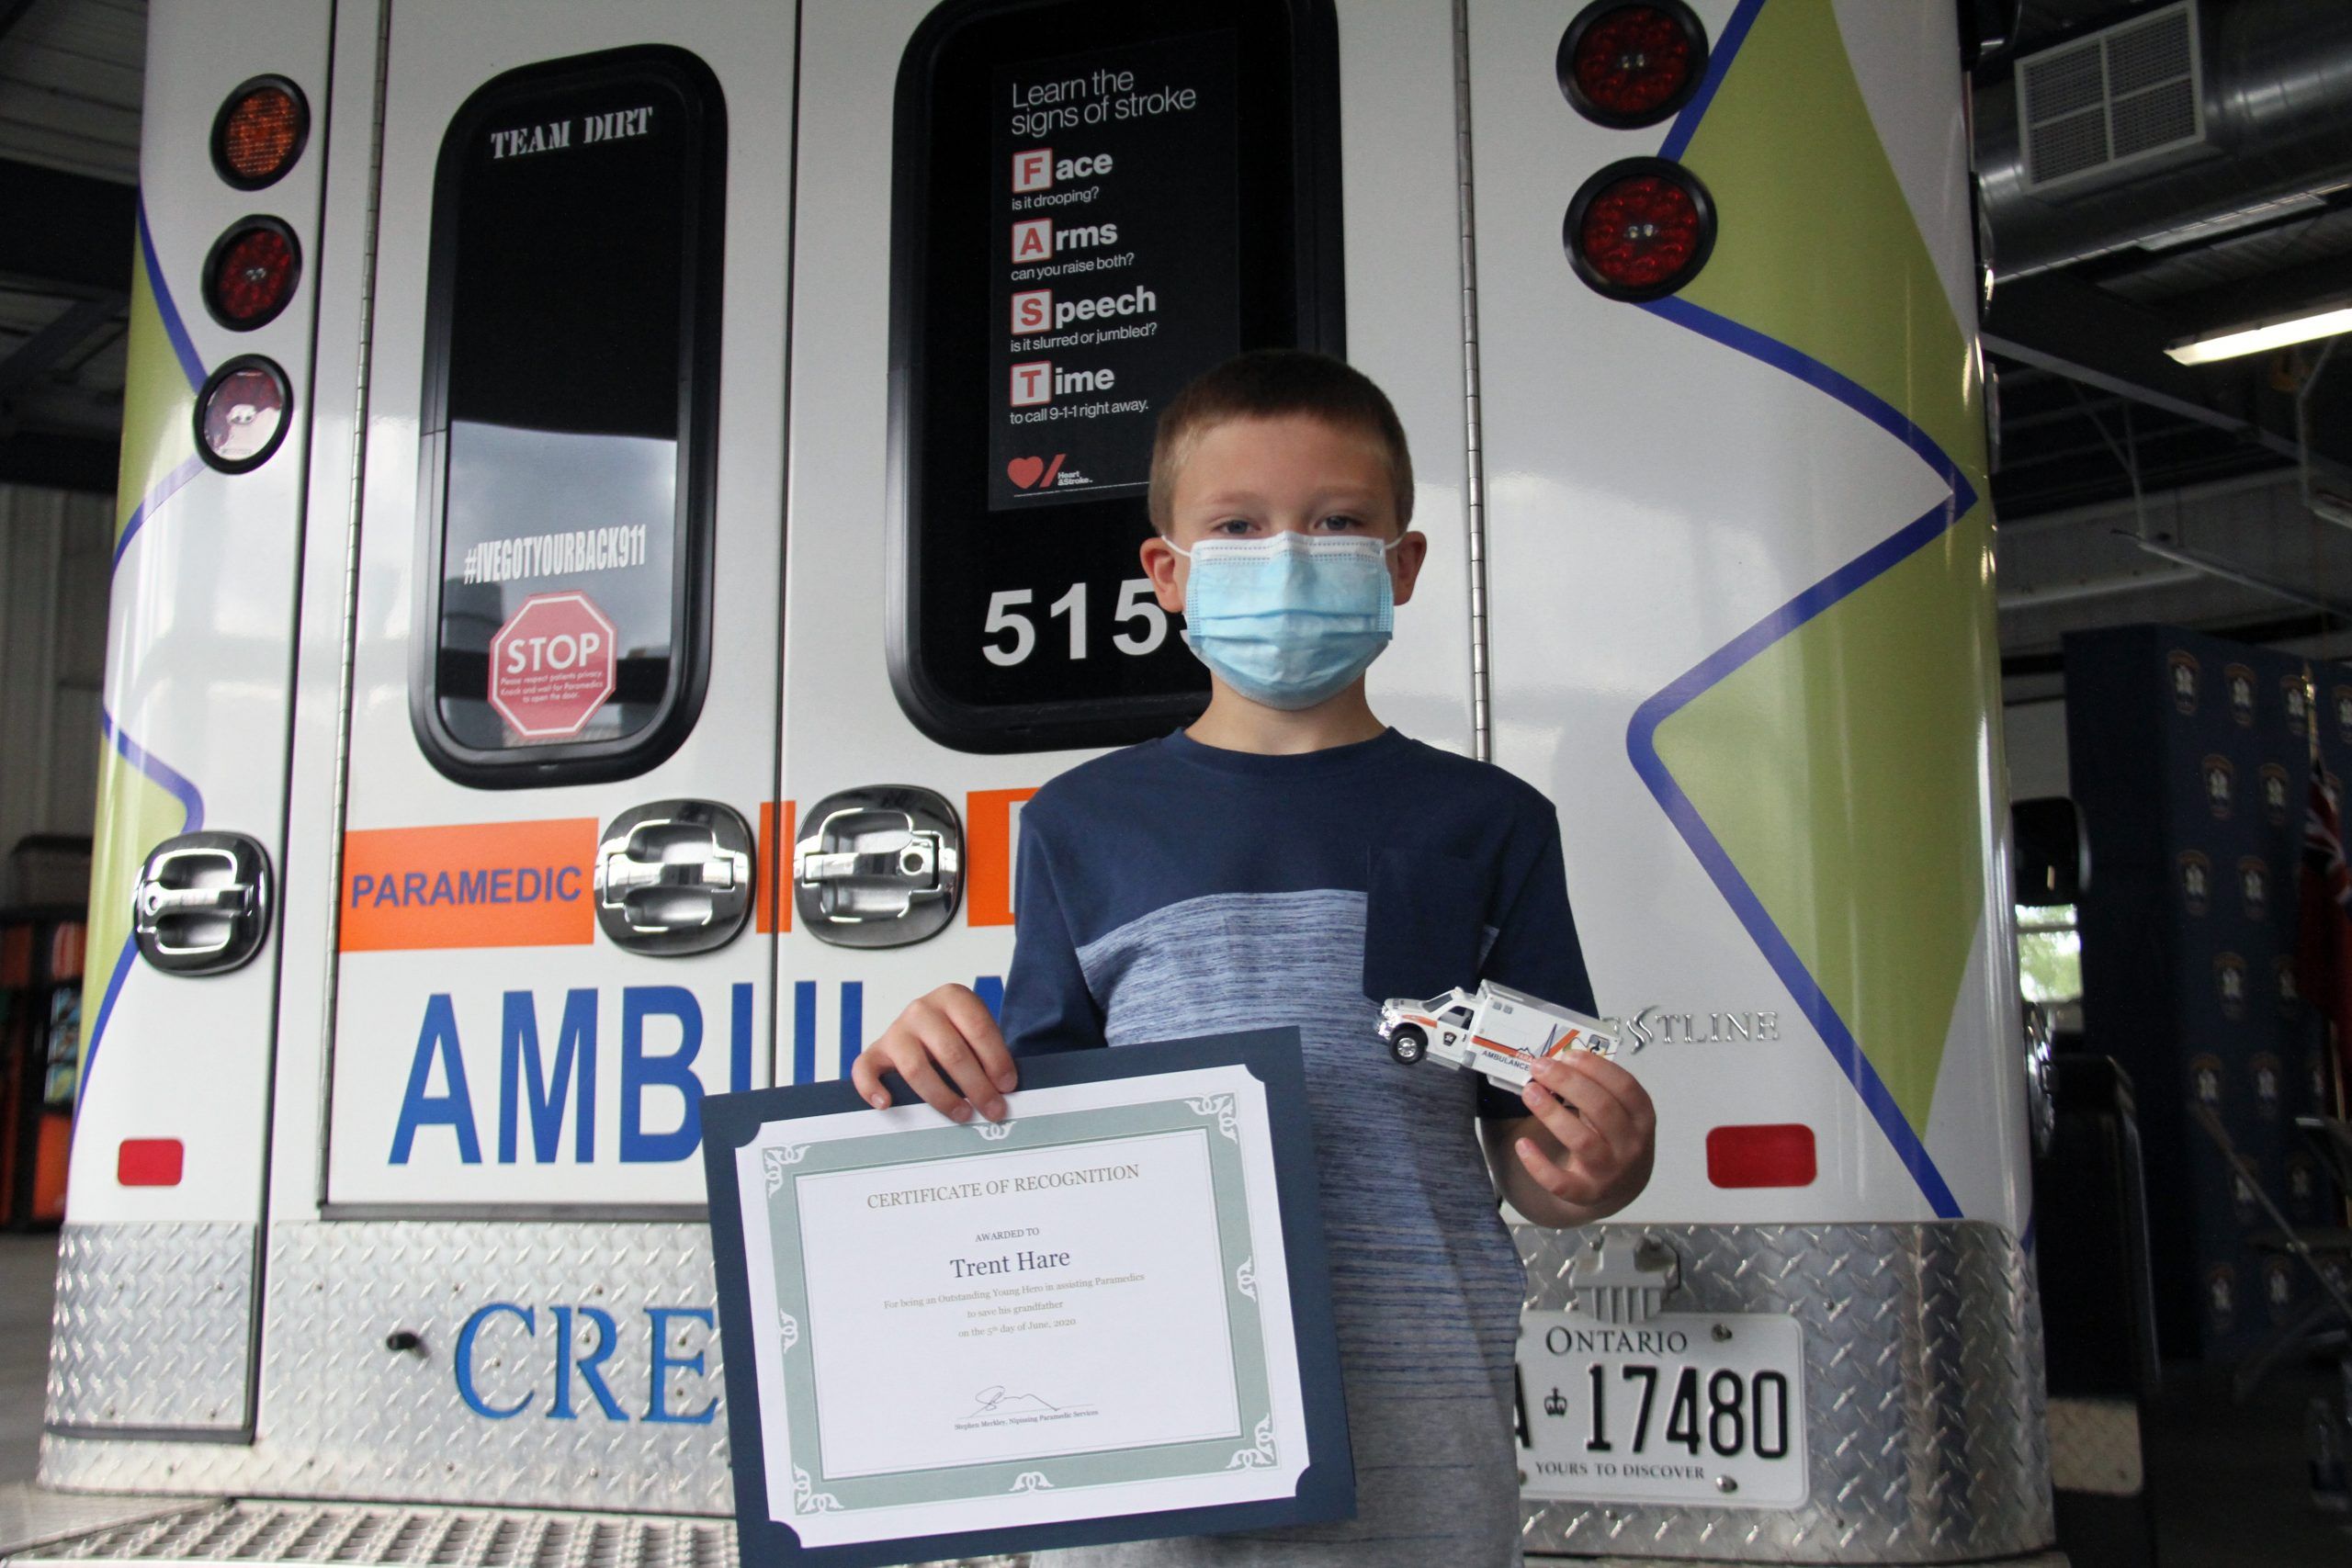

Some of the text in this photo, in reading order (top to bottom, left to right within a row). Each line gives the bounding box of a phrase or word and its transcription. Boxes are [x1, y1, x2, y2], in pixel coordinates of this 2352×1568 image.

[1012, 68, 1134, 108] Learn the
[1011, 85, 1196, 138] signs of stroke
[490, 106, 654, 160] TEAM DIRT
[1022, 152, 1114, 186] Face
[1012, 186, 1100, 210] is it drooping?
[1020, 222, 1118, 256] Arms
[1011, 252, 1135, 281] can you raise both?
[1021, 285, 1157, 330] Speech
[1011, 321, 1158, 353] is it slurred or jumbled?
[1020, 367, 1115, 399] Time
[1010, 399, 1149, 425] to call 9-1-1 right away.
[1057, 470, 1080, 479] Heart
[463, 524, 647, 585] #IVEGOTYOURBACK911
[981, 577, 1189, 667] 515
[506, 631, 601, 674] STOP
[350, 864, 583, 909] PARAMEDIC
[387, 975, 1006, 1166] AMBU
[1481, 1049, 1530, 1072] AMBULANCE
[866, 1164, 1140, 1210] CERTIFICATE OF RECOGNITION
[974, 1226, 1040, 1243] AWARDED TO
[949, 1249, 1071, 1279] Trent Hare
[883, 1300, 899, 1309] For
[900, 1298, 924, 1309] being
[938, 1290, 991, 1303] Outstanding
[992, 1287, 1021, 1299] Young
[1022, 1284, 1044, 1294] Hero
[1045, 1282, 1055, 1292] in
[1056, 1278, 1093, 1291] assisting
[1094, 1272, 1146, 1286] Paramedics
[967, 1300, 1064, 1319] to save his grandfather
[970, 1327, 985, 1337] the
[1000, 1323, 1015, 1336] day
[1016, 1322, 1025, 1332] of
[1053, 1317, 1077, 1327] 2020
[1545, 1325, 1689, 1358] ONTARIO
[955, 1421, 979, 1431] Stephen
[1009, 1415, 1038, 1427] Nipissing
[1039, 1412, 1072, 1423] Paramedic
[1072, 1409, 1099, 1418] Services
[1585, 1363, 1788, 1461] 17480
[1535, 1461, 1705, 1481] YOURS TO DISCOVER
